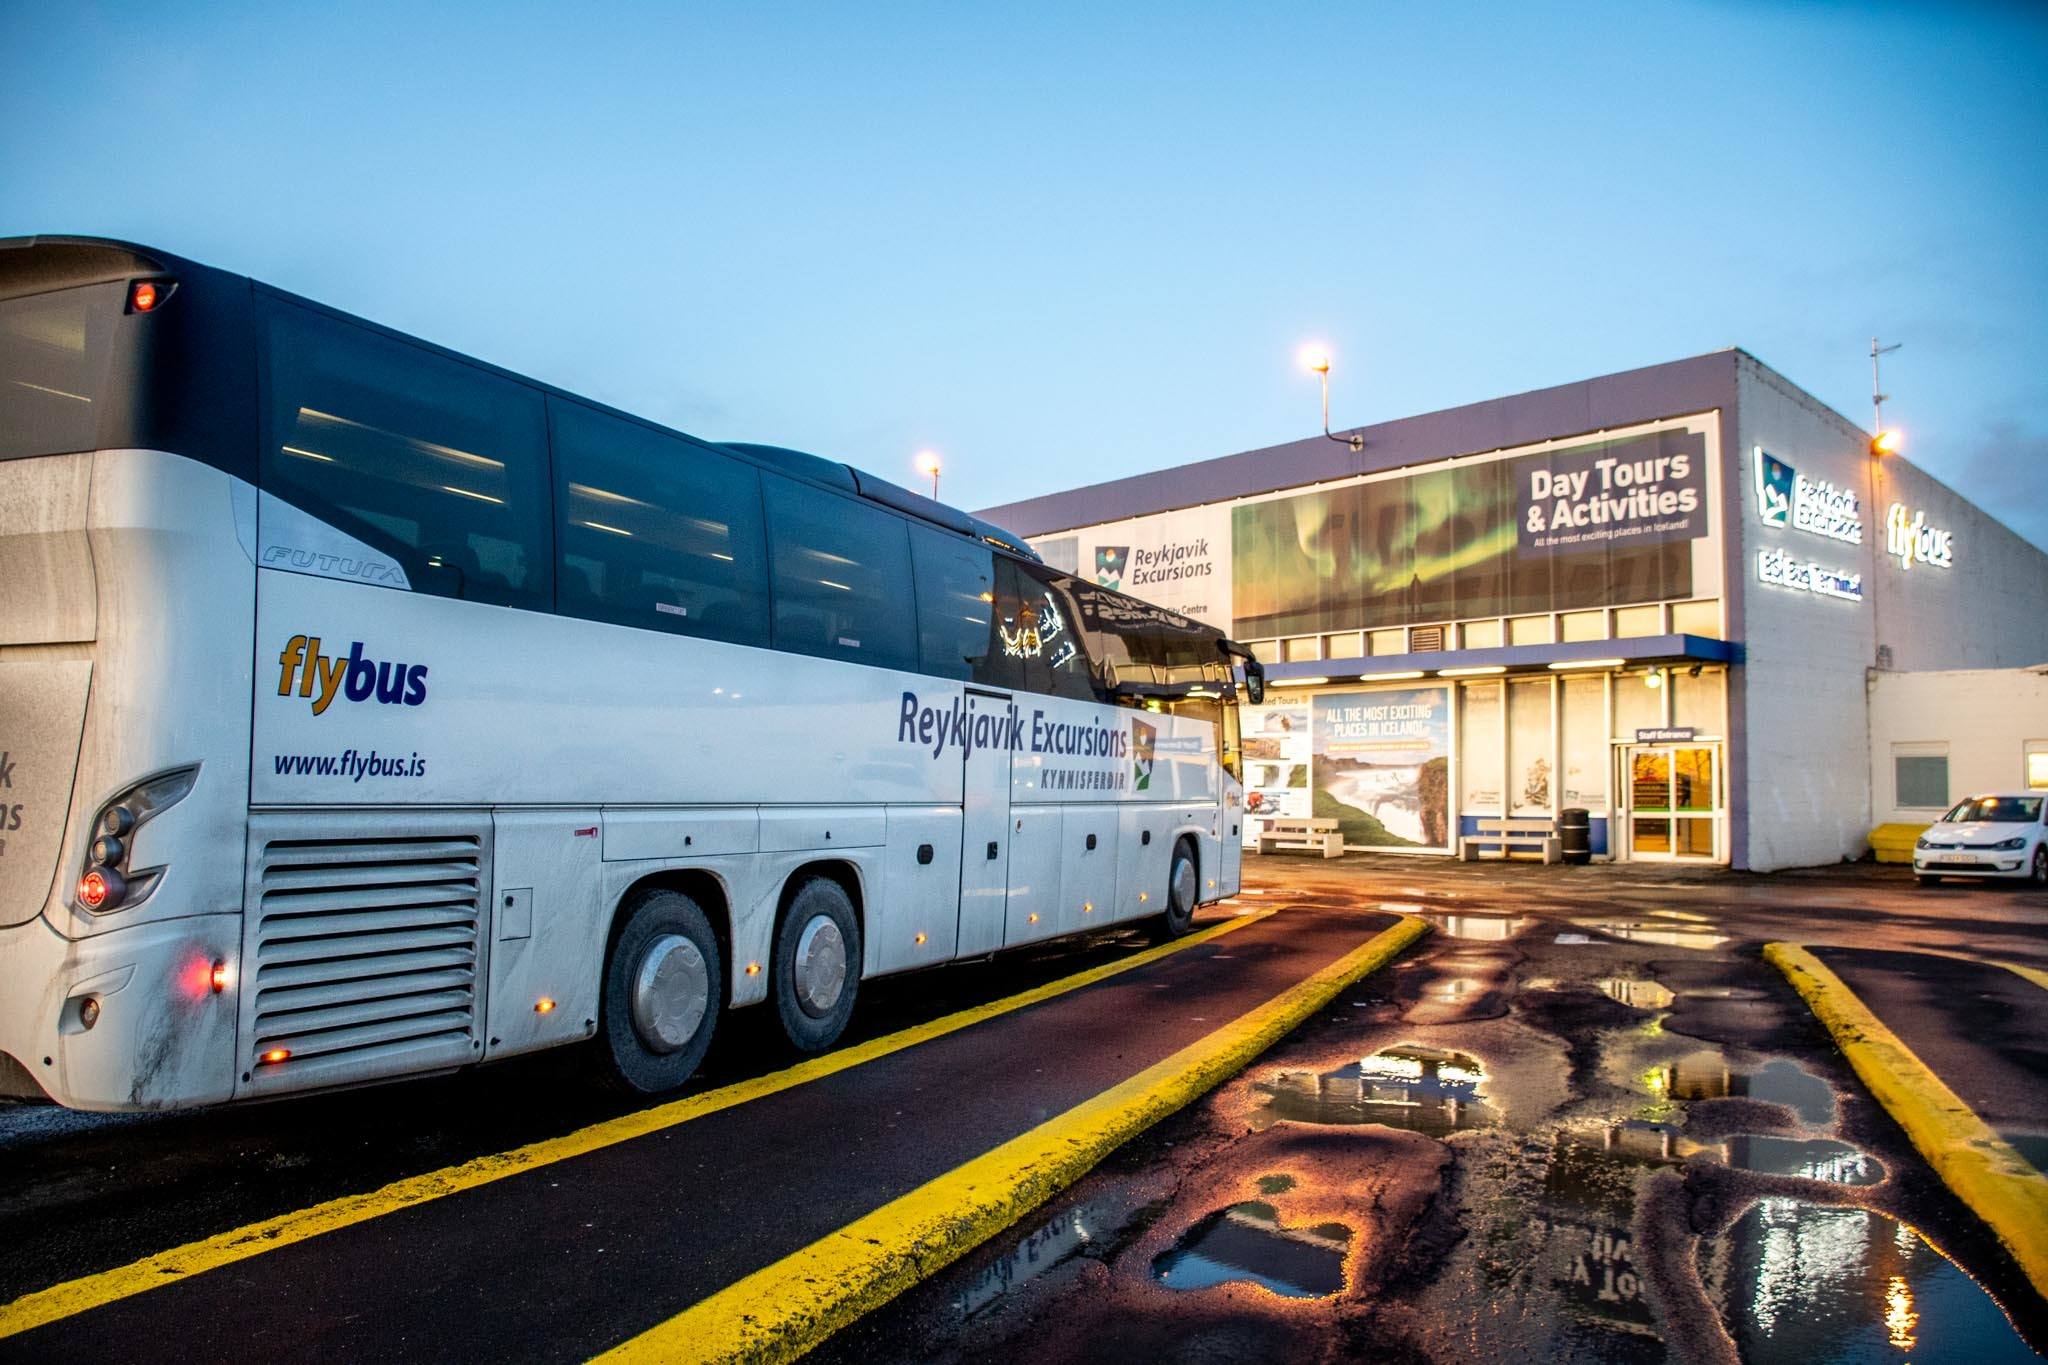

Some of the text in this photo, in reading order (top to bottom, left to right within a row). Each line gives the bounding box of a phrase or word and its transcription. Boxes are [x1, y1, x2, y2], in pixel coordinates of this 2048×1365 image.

[1531, 454, 1691, 501] Day Tours
[1526, 486, 1698, 533] & Activities
[1534, 519, 1689, 547] All the most exciting places in Iceland!
[263, 546, 405, 583] FUTURA
[1135, 538, 1208, 568] Reykjavik
[1132, 561, 1212, 585] Excursions
[1181, 605, 1208, 615] Centre
[277, 635, 429, 717] flybus
[898, 691, 1128, 760] Reykjavik Excursions
[1326, 703, 1432, 723] ALL THE MOST EXCITING
[1334, 722, 1367, 737] PLACES
[1368, 721, 1379, 736] IN
[1638, 730, 1691, 740] Staff Entrance
[274, 749, 427, 783] www.flybus.is
